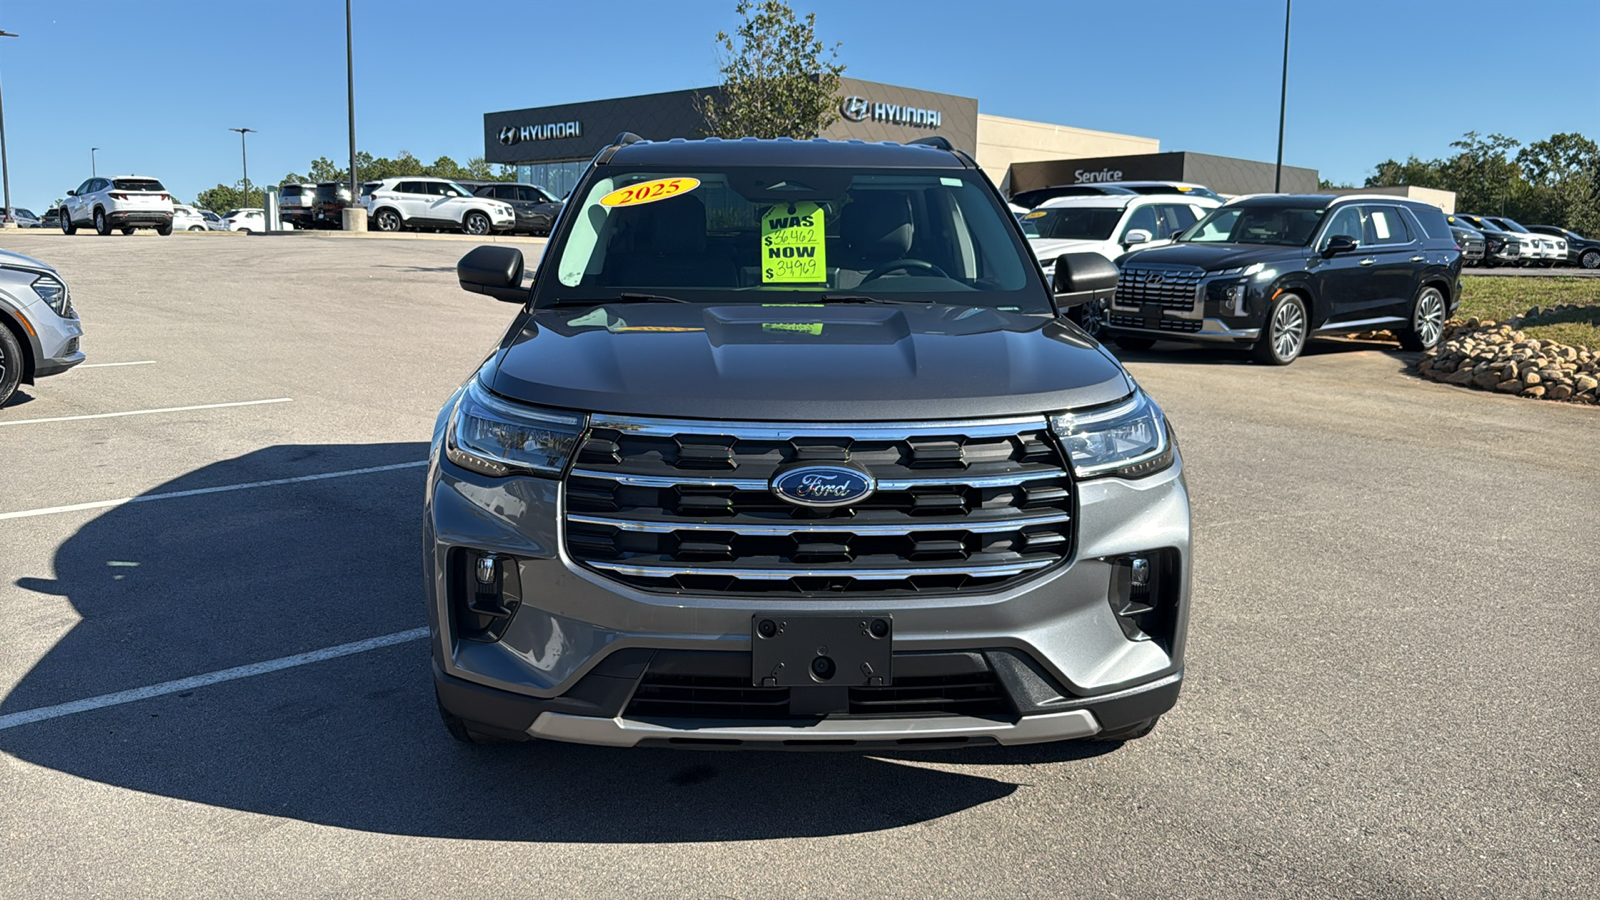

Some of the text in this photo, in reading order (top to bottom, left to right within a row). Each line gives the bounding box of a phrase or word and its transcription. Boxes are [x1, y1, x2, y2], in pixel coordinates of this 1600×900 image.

[874, 102, 942, 126] HYUNDAI
[520, 120, 580, 141] HYUNDAI
[1074, 168, 1123, 183] Service
[618, 179, 682, 204] 2025
[768, 215, 814, 230] WAS
[768, 246, 816, 258] NOW
[796, 473, 851, 497] Ford
